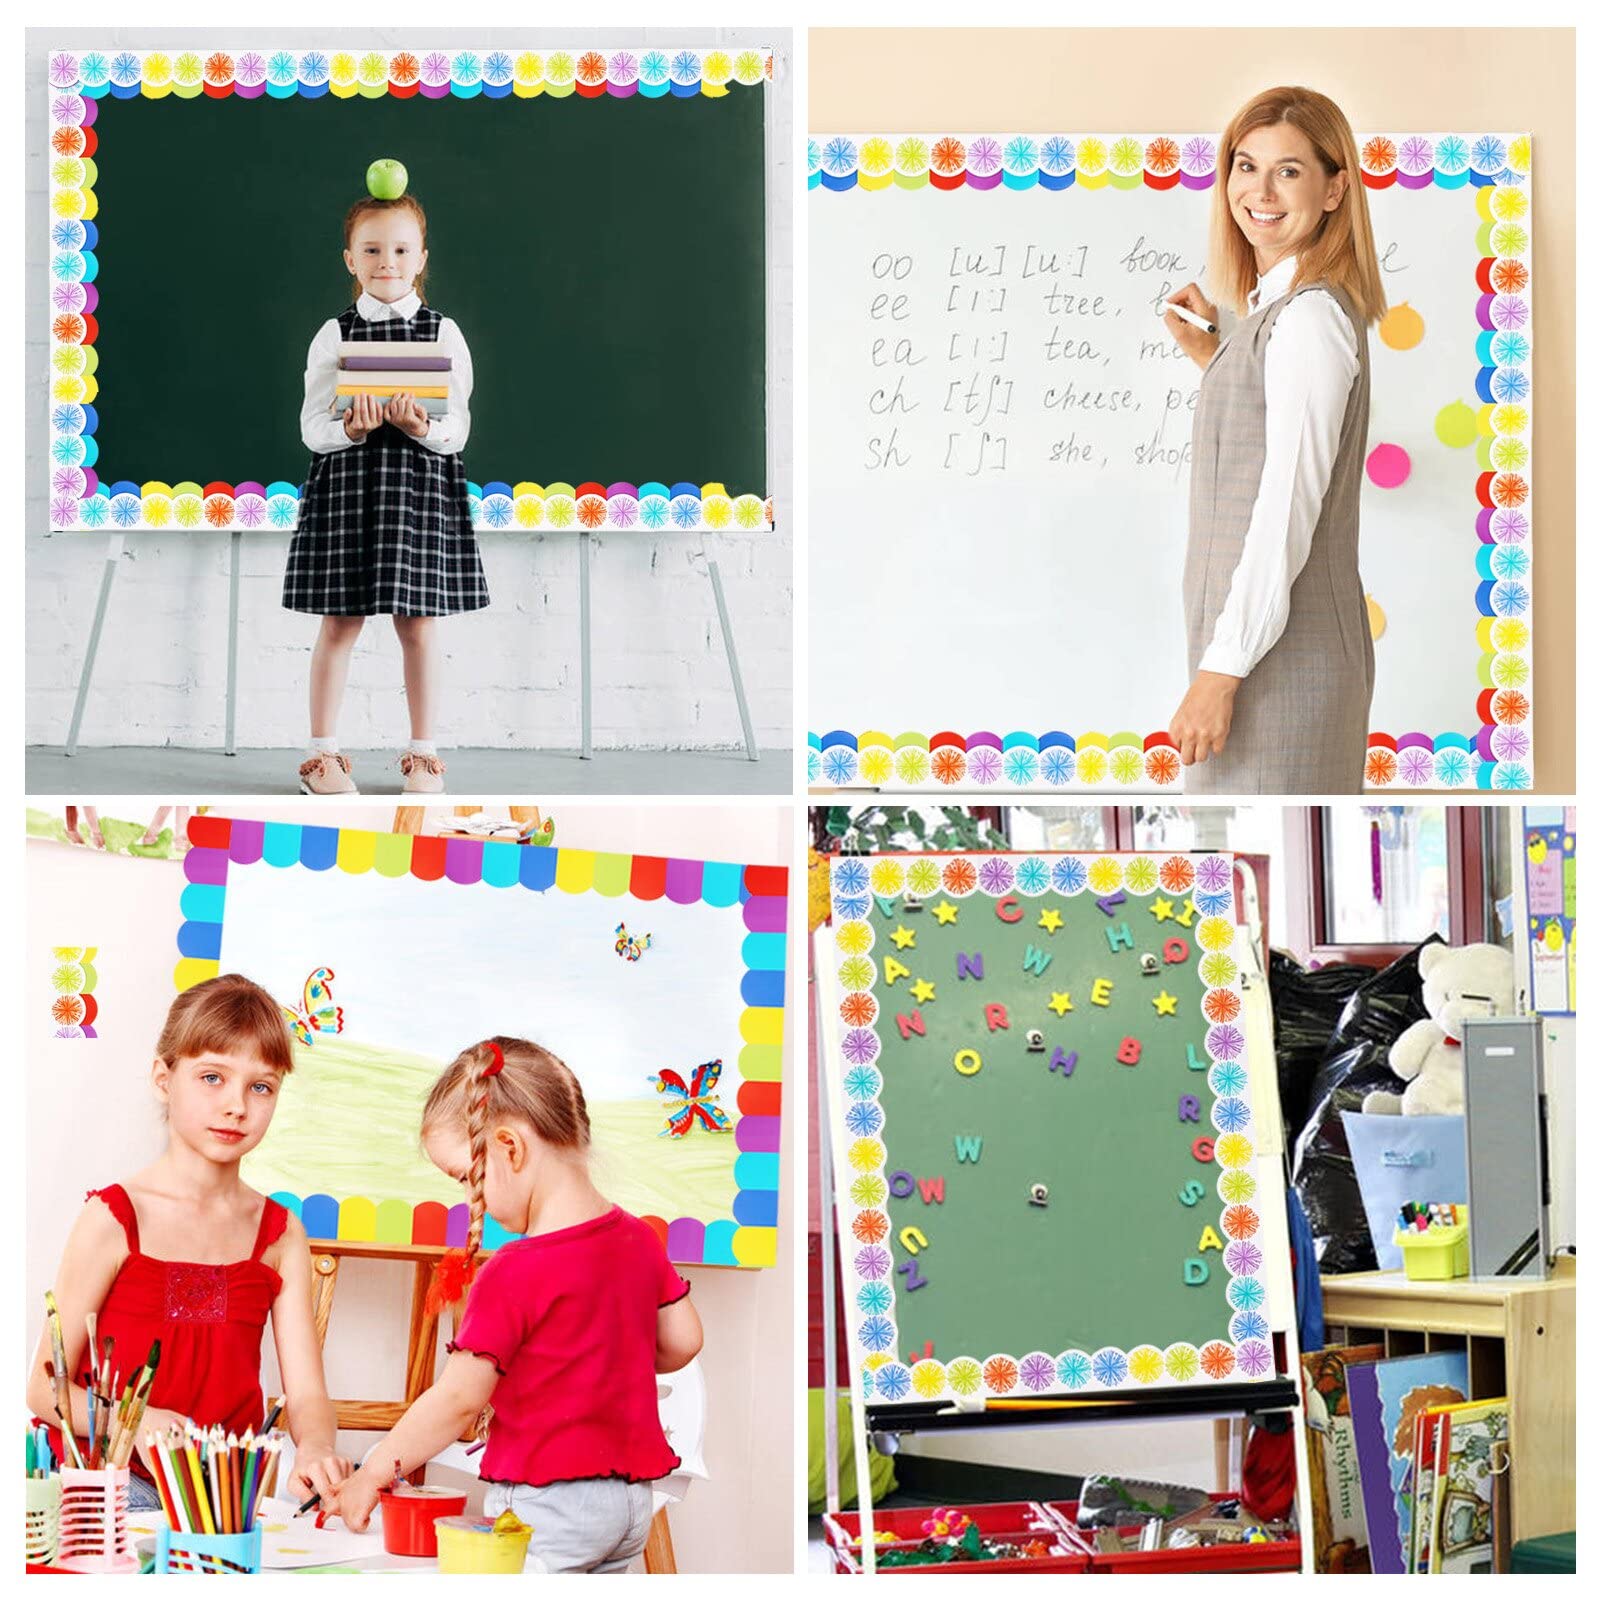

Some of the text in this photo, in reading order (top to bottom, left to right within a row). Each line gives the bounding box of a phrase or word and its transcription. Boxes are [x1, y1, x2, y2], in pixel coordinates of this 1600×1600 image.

[871, 294, 911, 321] ee
[872, 338, 927, 367] ea
[869, 376, 920, 414] ch
[996, 896, 1024, 924] C
[1105, 922, 1135, 953] H
[884, 956, 911, 986] A
[957, 953, 984, 980] N
[1091, 978, 1114, 1007] E
[897, 1010, 926, 1040] N
[984, 1003, 1010, 1032] R
[1050, 1047, 1078, 1077] H
[1117, 1036, 1142, 1066] B
[1186, 1042, 1207, 1072] L
[1179, 1095, 1201, 1122] R
[955, 1136, 982, 1163] W
[1179, 1180, 1206, 1207] S
[1199, 1225, 1224, 1252] A
[1183, 1258, 1210, 1286] D
[1333, 1428, 1353, 1520] Rhythms
